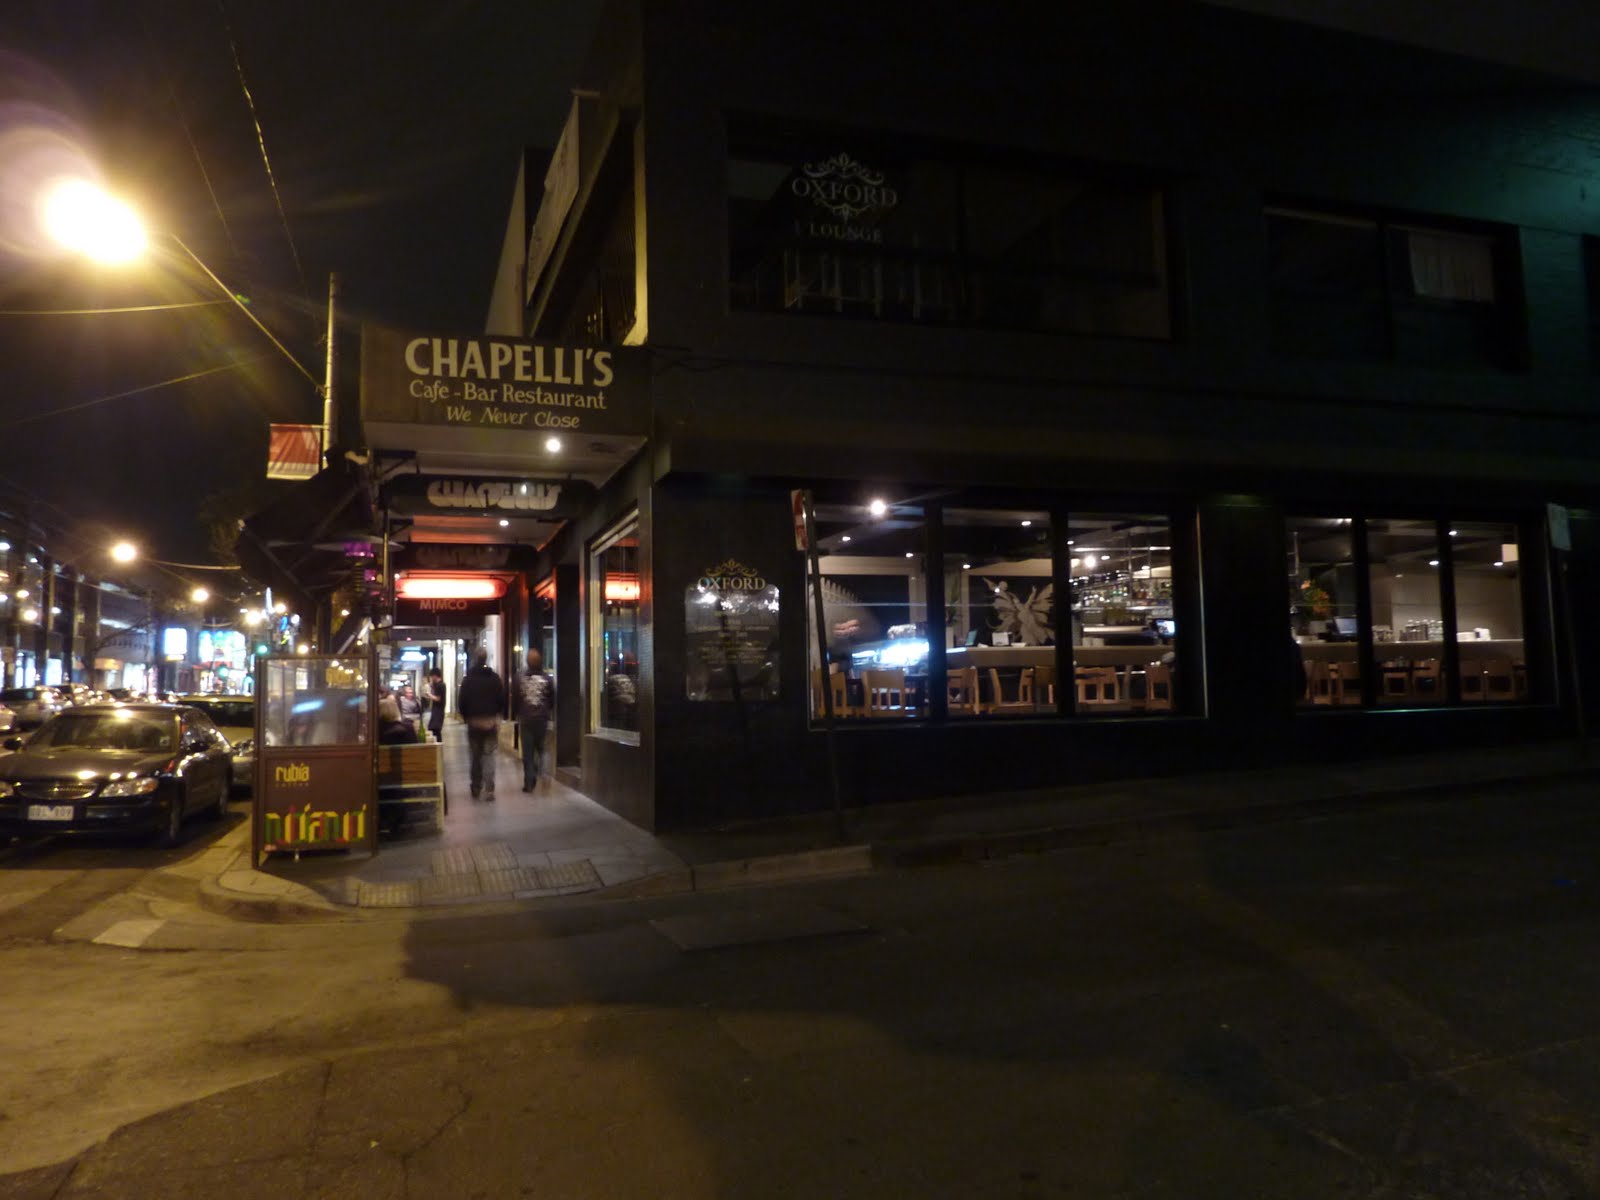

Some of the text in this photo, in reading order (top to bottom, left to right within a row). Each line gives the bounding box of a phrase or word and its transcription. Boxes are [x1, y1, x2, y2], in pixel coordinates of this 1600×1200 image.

[791, 175, 898, 209] OXFORD
[809, 222, 882, 242] LOUNGE
[404, 336, 615, 388] CHAPELLI'S
[409, 379, 450, 402] Cafe
[463, 381, 498, 402] Bar
[502, 383, 608, 410] Restaurant
[446, 405, 581, 429] We Never Close
[697, 576, 767, 591] OXFORD
[419, 599, 468, 613] MIMCO
